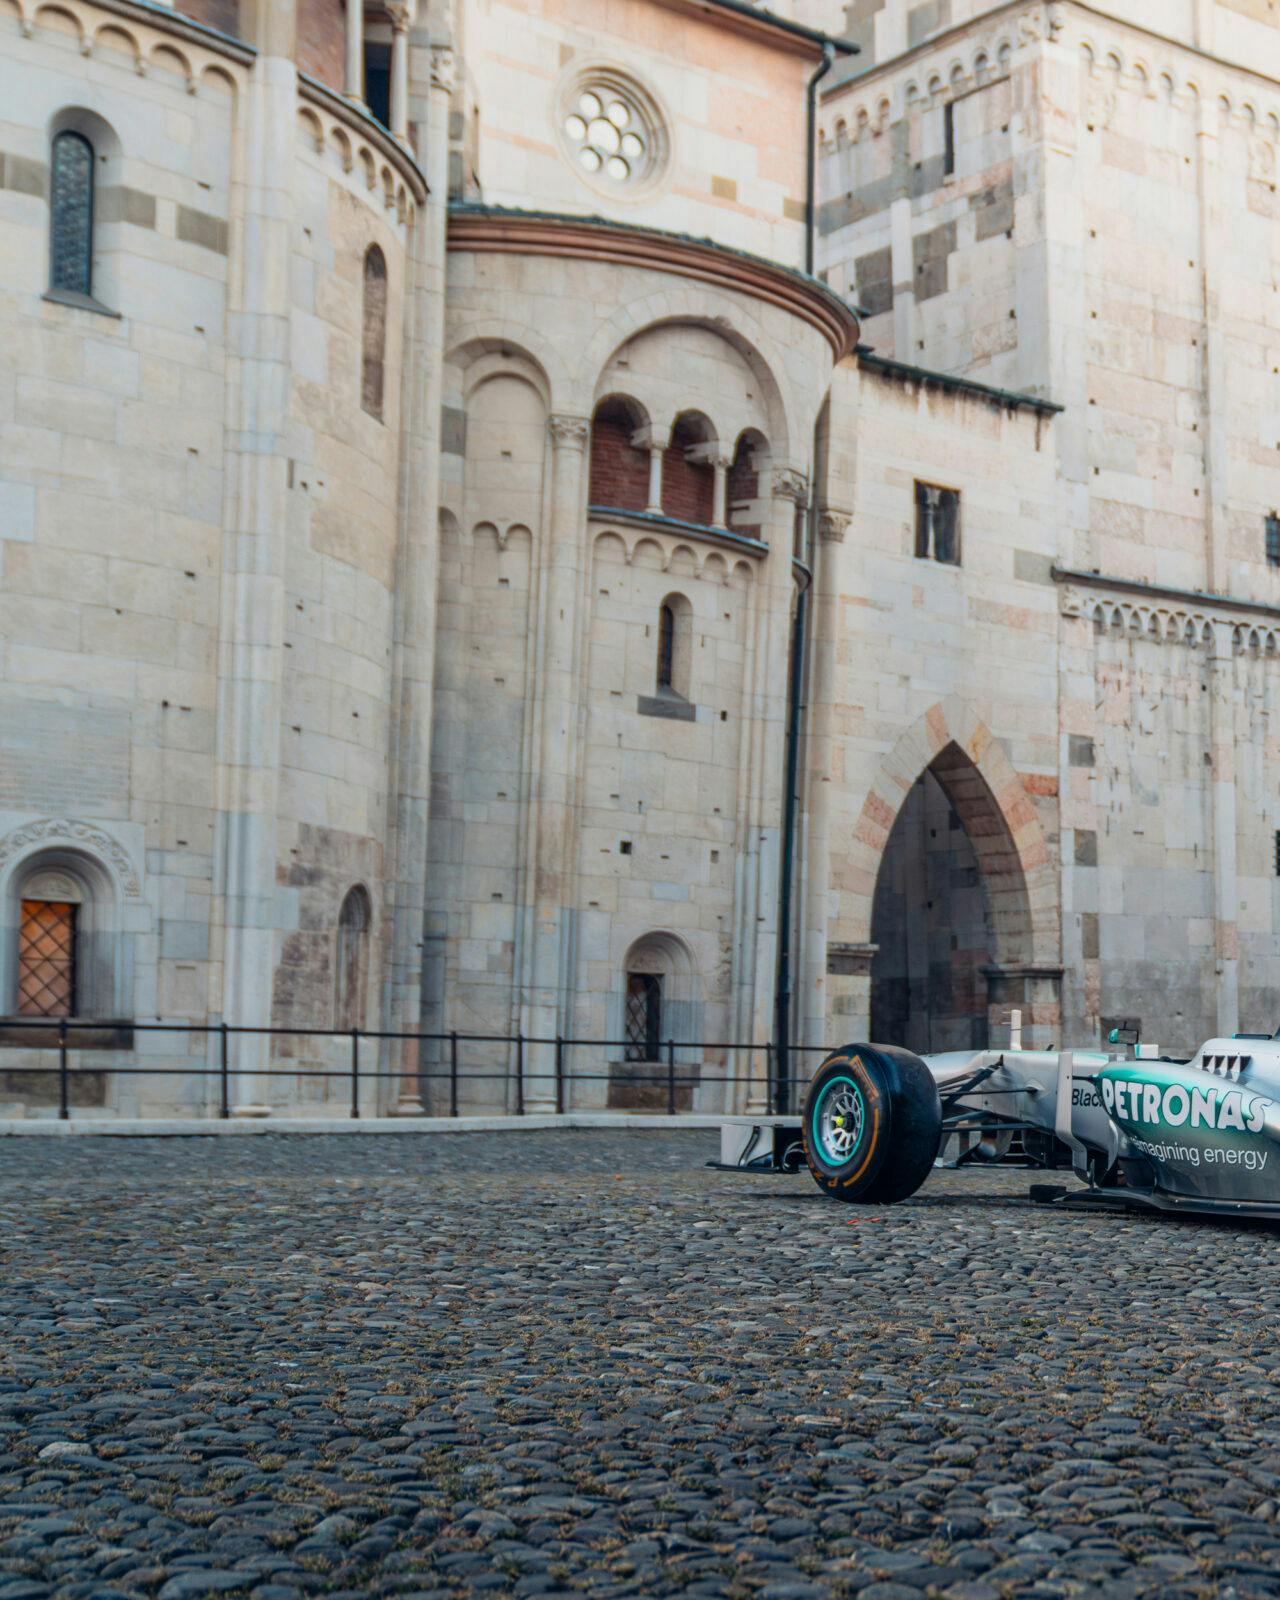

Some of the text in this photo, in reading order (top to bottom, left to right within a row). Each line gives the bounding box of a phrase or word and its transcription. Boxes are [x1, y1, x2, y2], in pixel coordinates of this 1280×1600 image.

[1072, 1088, 1102, 1107] Blac
[1101, 1077, 1274, 1133] PETRONAS
[1203, 1147, 1268, 1170] energy
